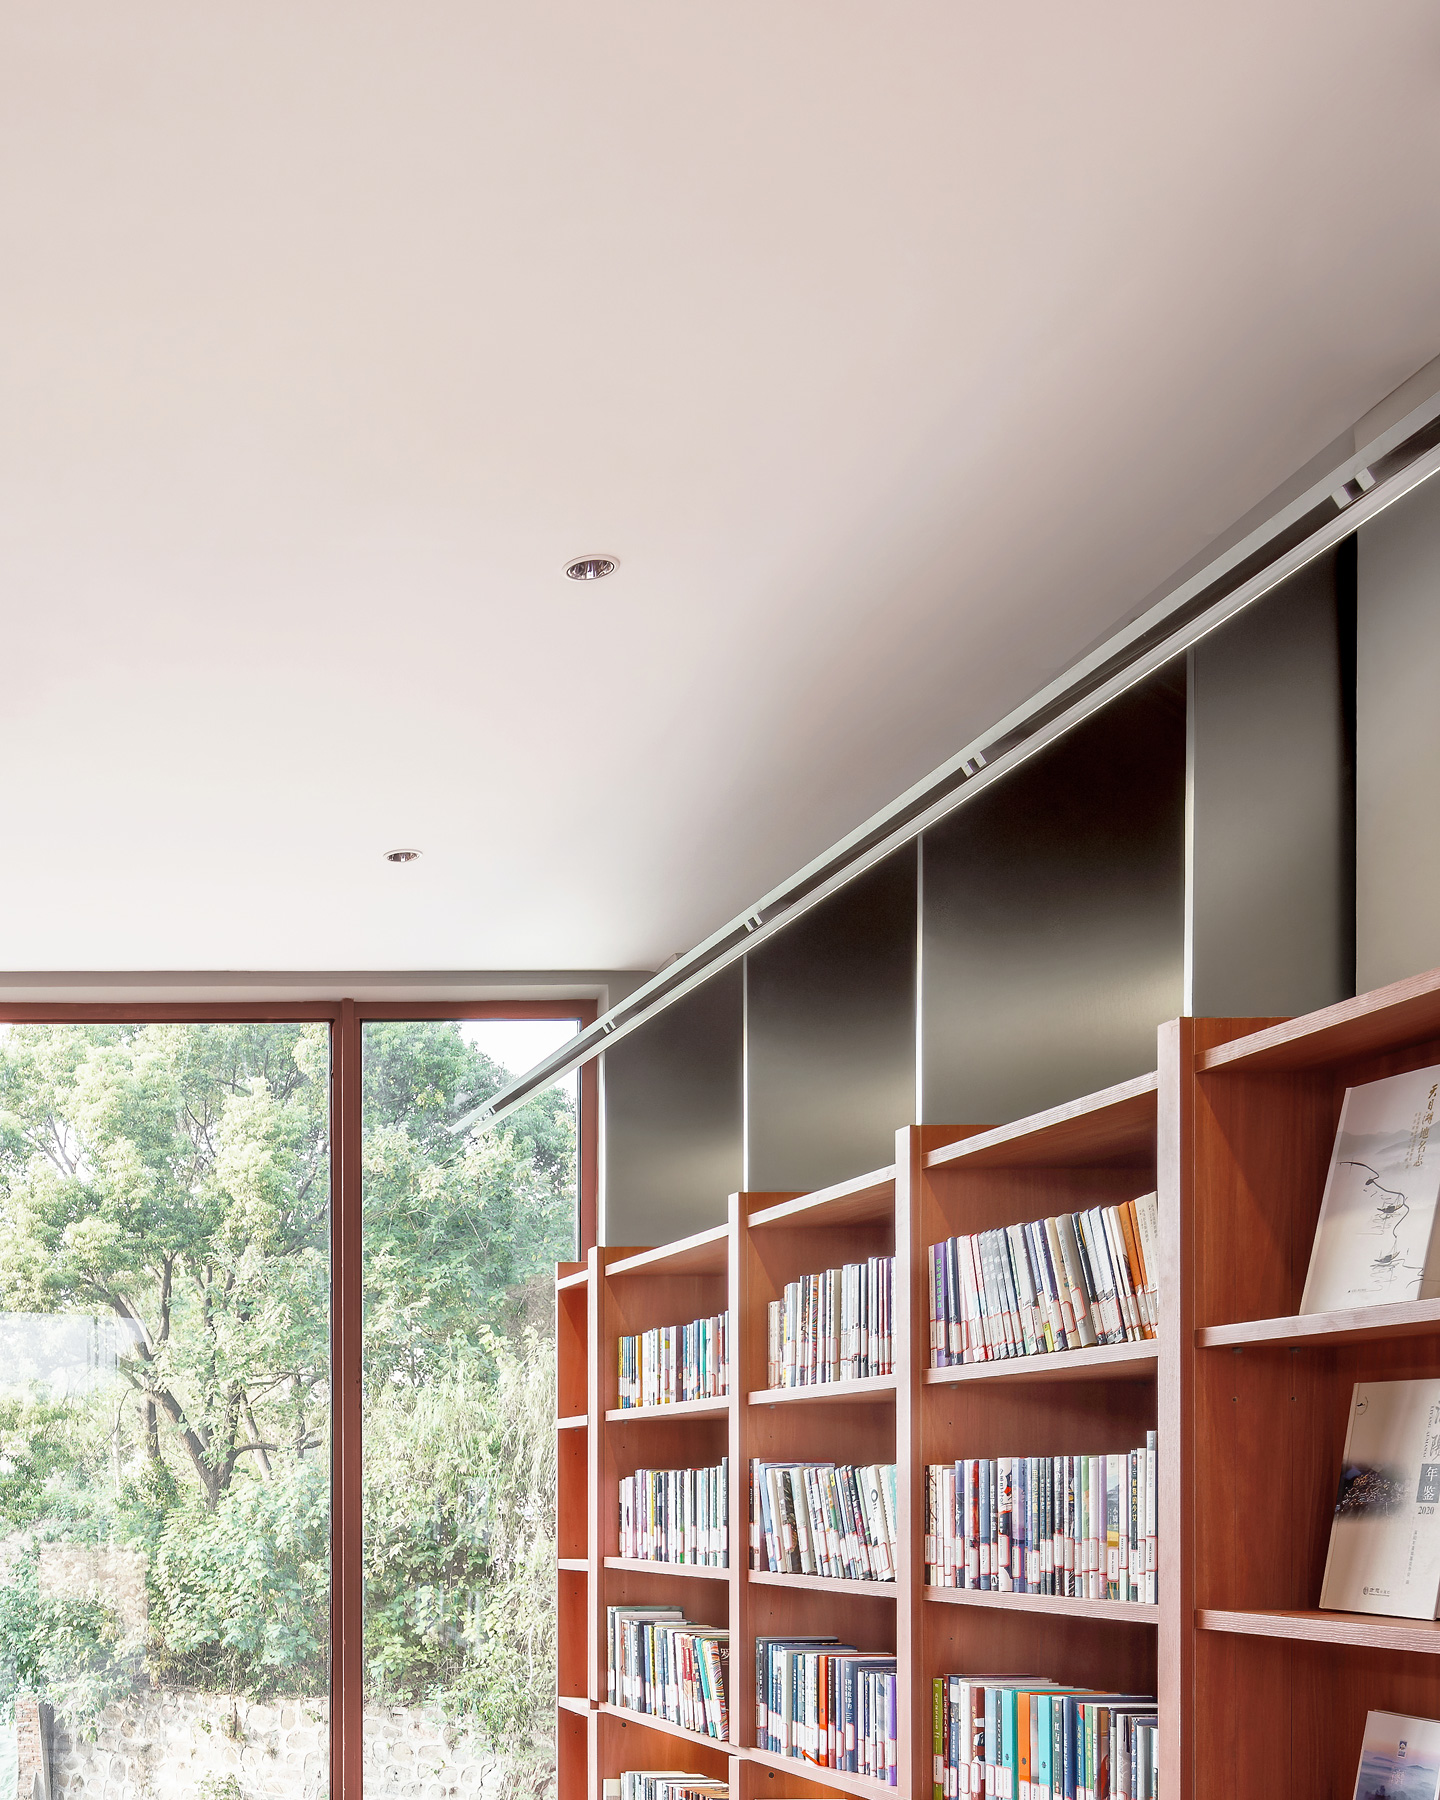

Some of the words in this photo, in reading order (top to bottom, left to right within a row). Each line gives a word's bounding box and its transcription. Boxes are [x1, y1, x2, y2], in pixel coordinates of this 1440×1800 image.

[1413, 1083, 1438, 1167] 天目湖地名志
[1422, 1466, 1438, 1501] 年鉴
[1418, 1506, 1435, 1516] 2020
